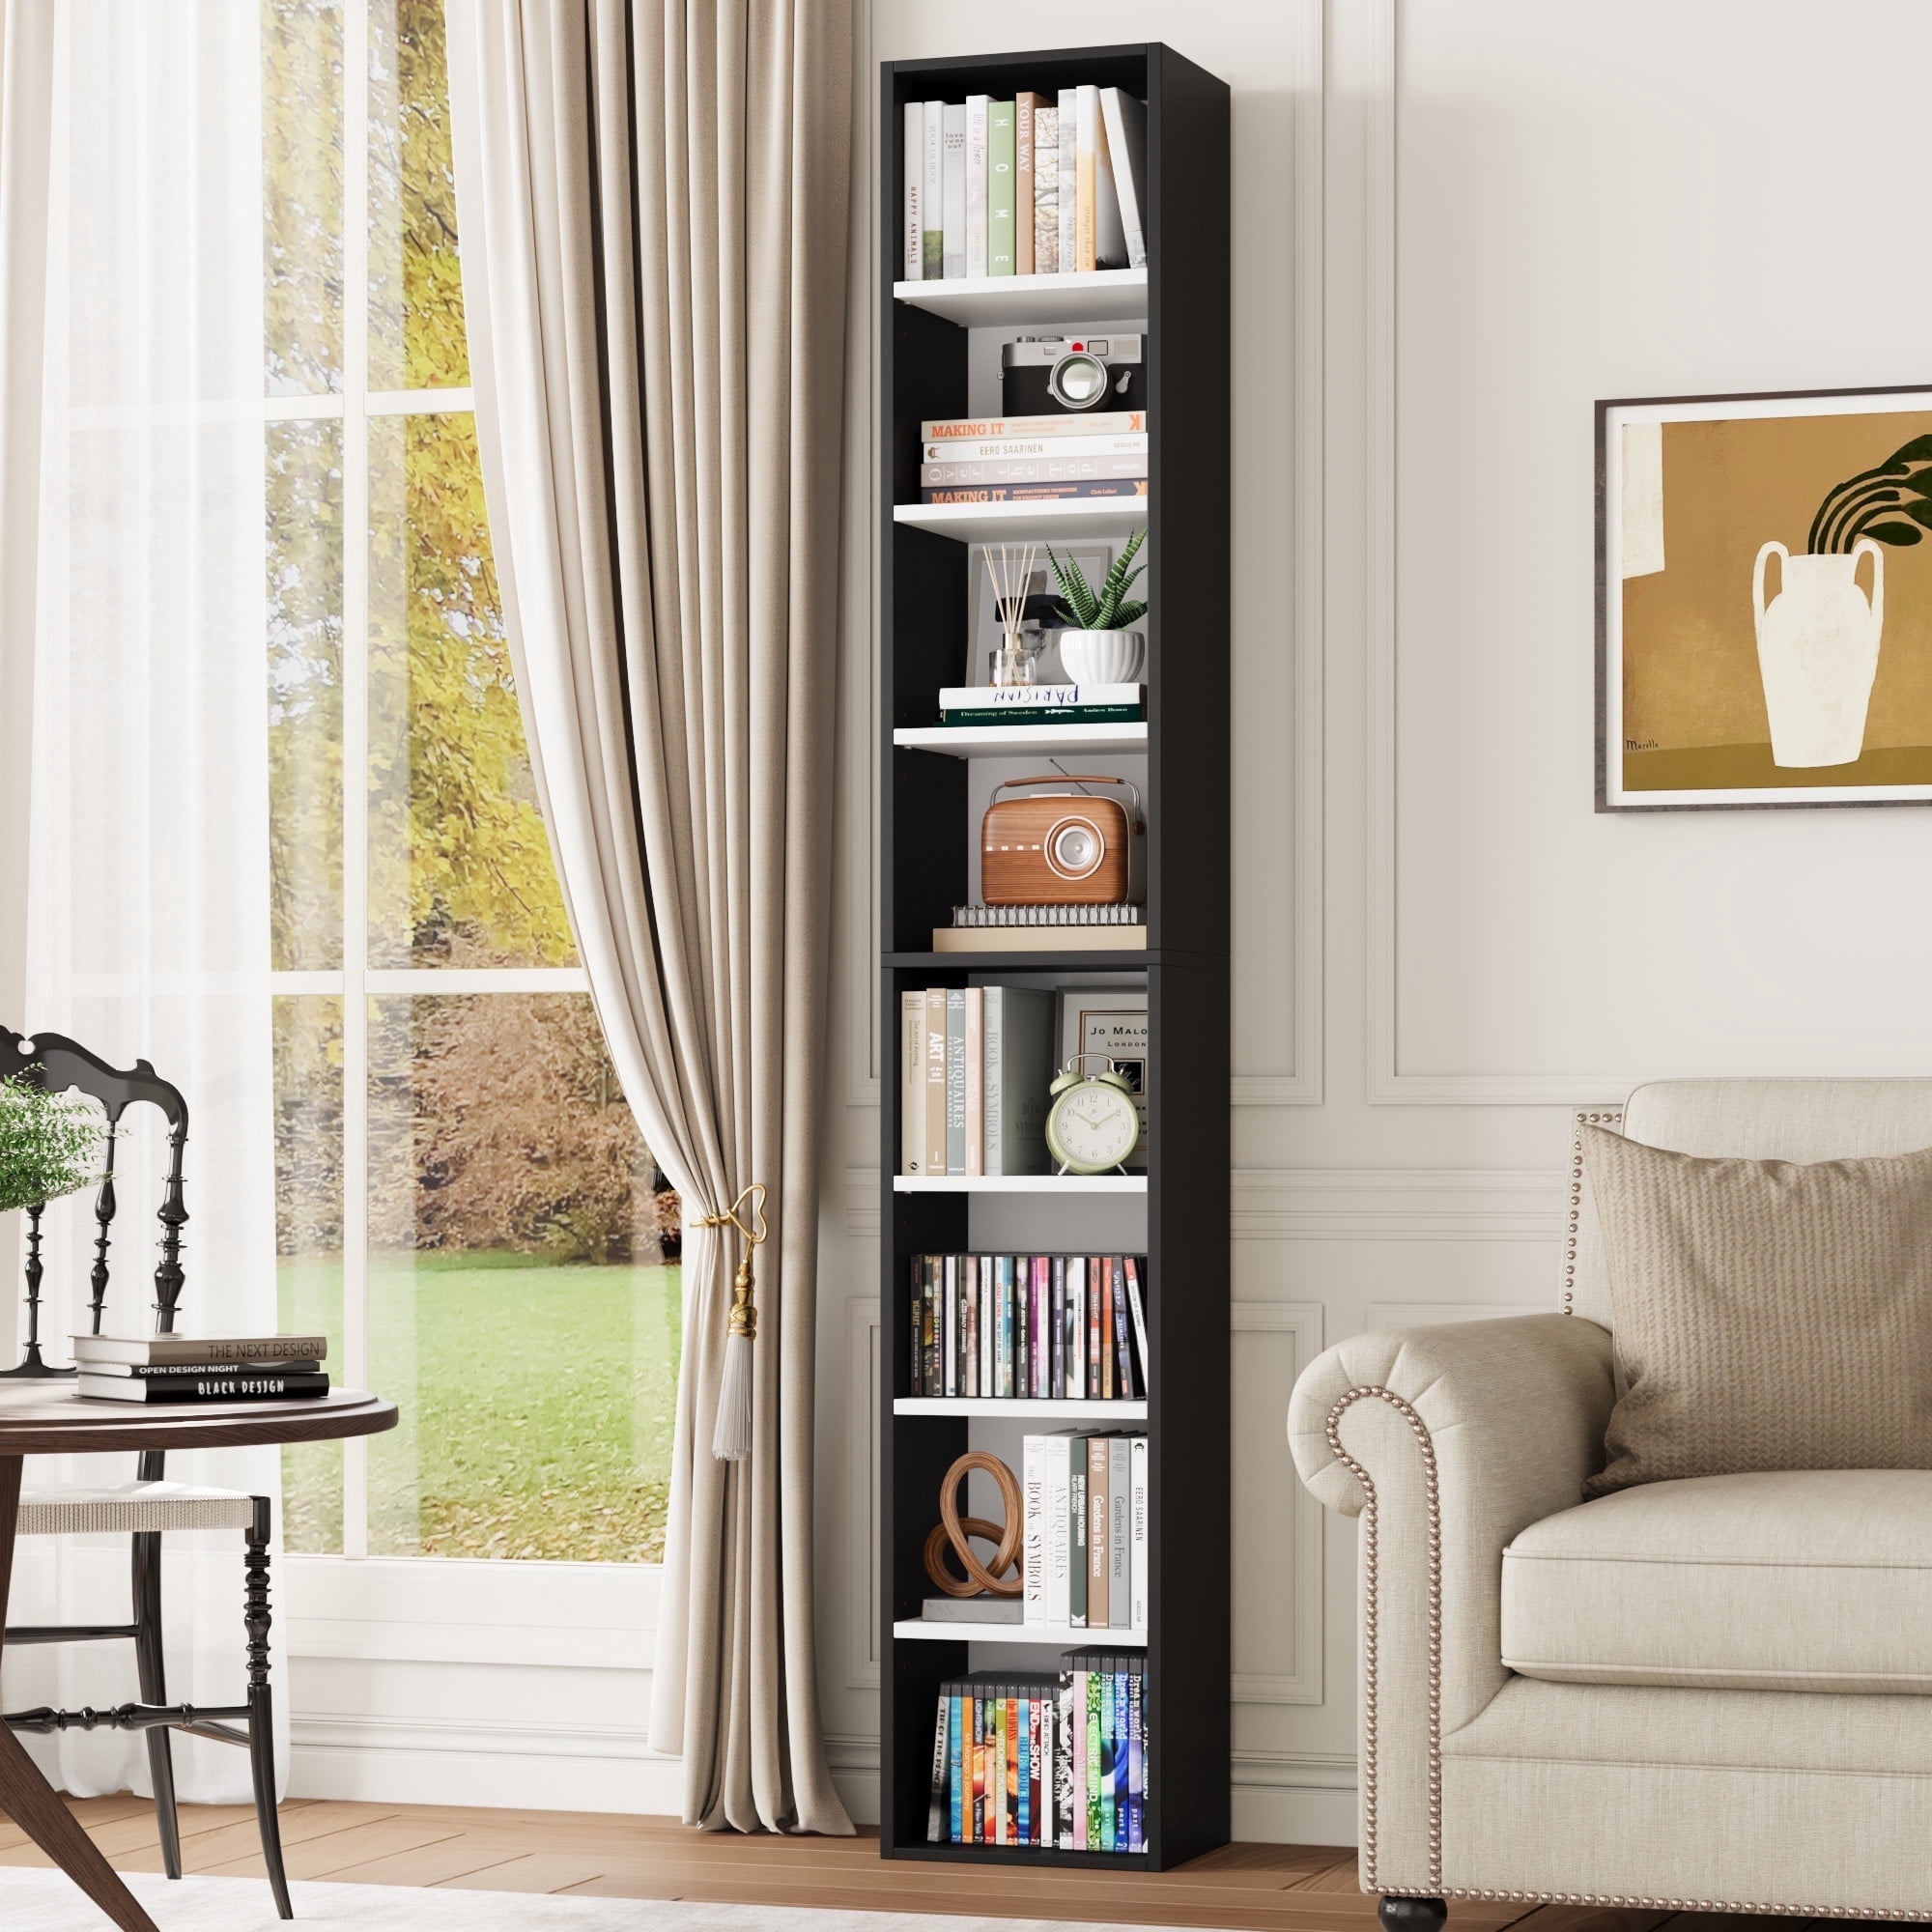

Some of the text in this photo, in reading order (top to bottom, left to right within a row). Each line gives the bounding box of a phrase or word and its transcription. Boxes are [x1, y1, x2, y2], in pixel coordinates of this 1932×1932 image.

[1019, 100, 1030, 173] YOUR WAY
[931, 423, 987, 438] MAKING
[991, 422, 1005, 435] IT
[980, 443, 1043, 456] EERO SAARINEN
[931, 490, 989, 504] MAKING
[991, 489, 1007, 502] IT
[929, 1032, 945, 1063] ART
[987, 1032, 998, 1069] BOOK
[952, 1037, 964, 1128] ANTIQUAIRES
[987, 1084, 999, 1151] SYMBOLS
[168, 1365, 206, 1374] DESIGN
[208, 1364, 240, 1373] NIGHT
[208, 1343, 320, 1358] THE NEXT DESIGN
[197, 1379, 284, 1395] BLACK DESIGN
[1028, 1482, 1041, 1519] BOOK
[1053, 1486, 1066, 1579] ANTIQUAIRES
[1094, 1495, 1104, 1577] Gardens in France
[1114, 1495, 1124, 1577] Gardens in France
[1028, 1534, 1041, 1602] SYMBOLS
[1030, 1702, 1039, 1725] END
[1030, 1745, 1039, 1780] SHOW
[1089, 1713, 1099, 1803] ELECTRIC MIND
